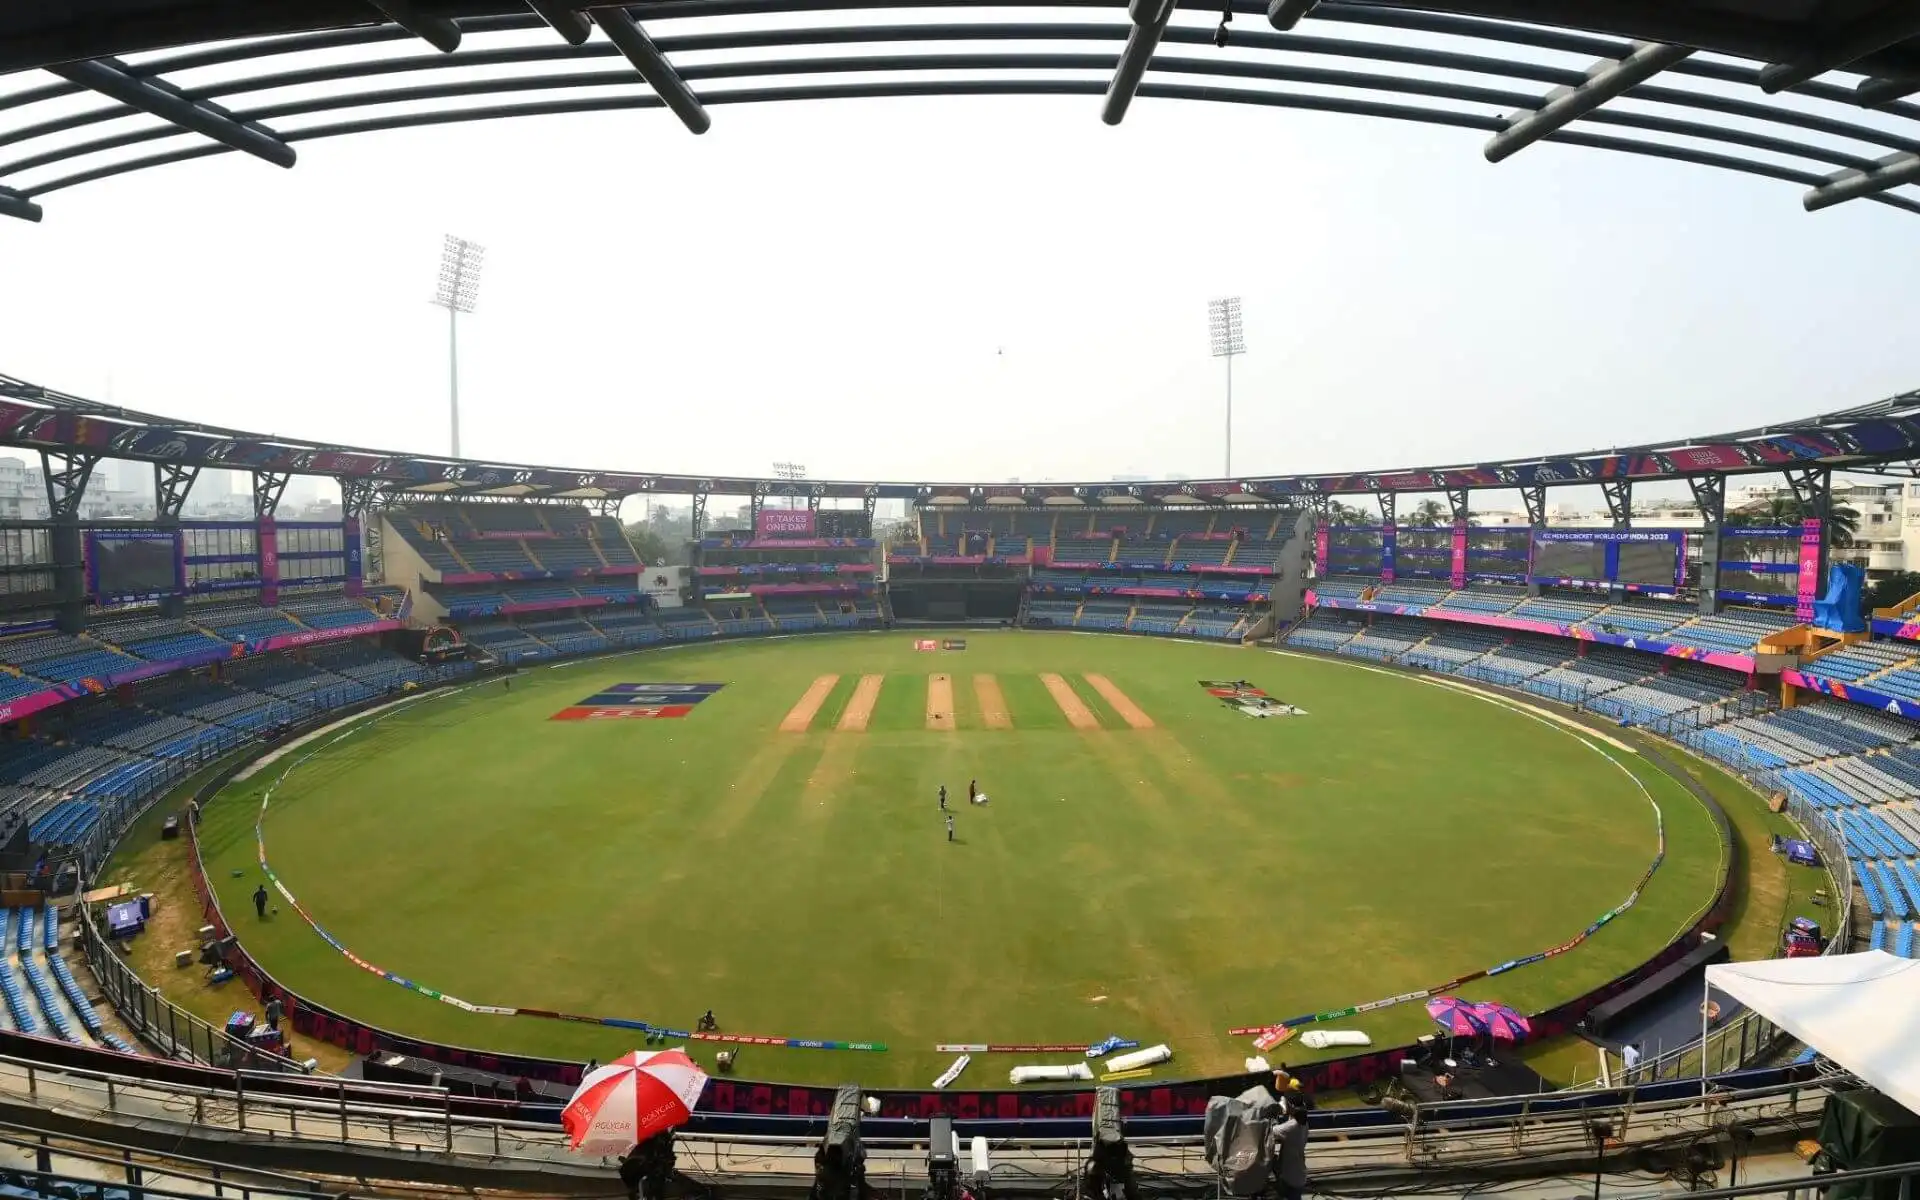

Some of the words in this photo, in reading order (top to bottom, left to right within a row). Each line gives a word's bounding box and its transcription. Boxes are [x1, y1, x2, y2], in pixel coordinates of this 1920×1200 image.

[766, 515, 775, 523] IT
[776, 515, 807, 523] TAKES
[766, 523, 787, 531] ONE
[788, 523, 807, 531] DAY
[1650, 533, 1668, 541] 2023
[641, 1100, 676, 1124] POLYCAB
[594, 1120, 632, 1130] POLYCAB
